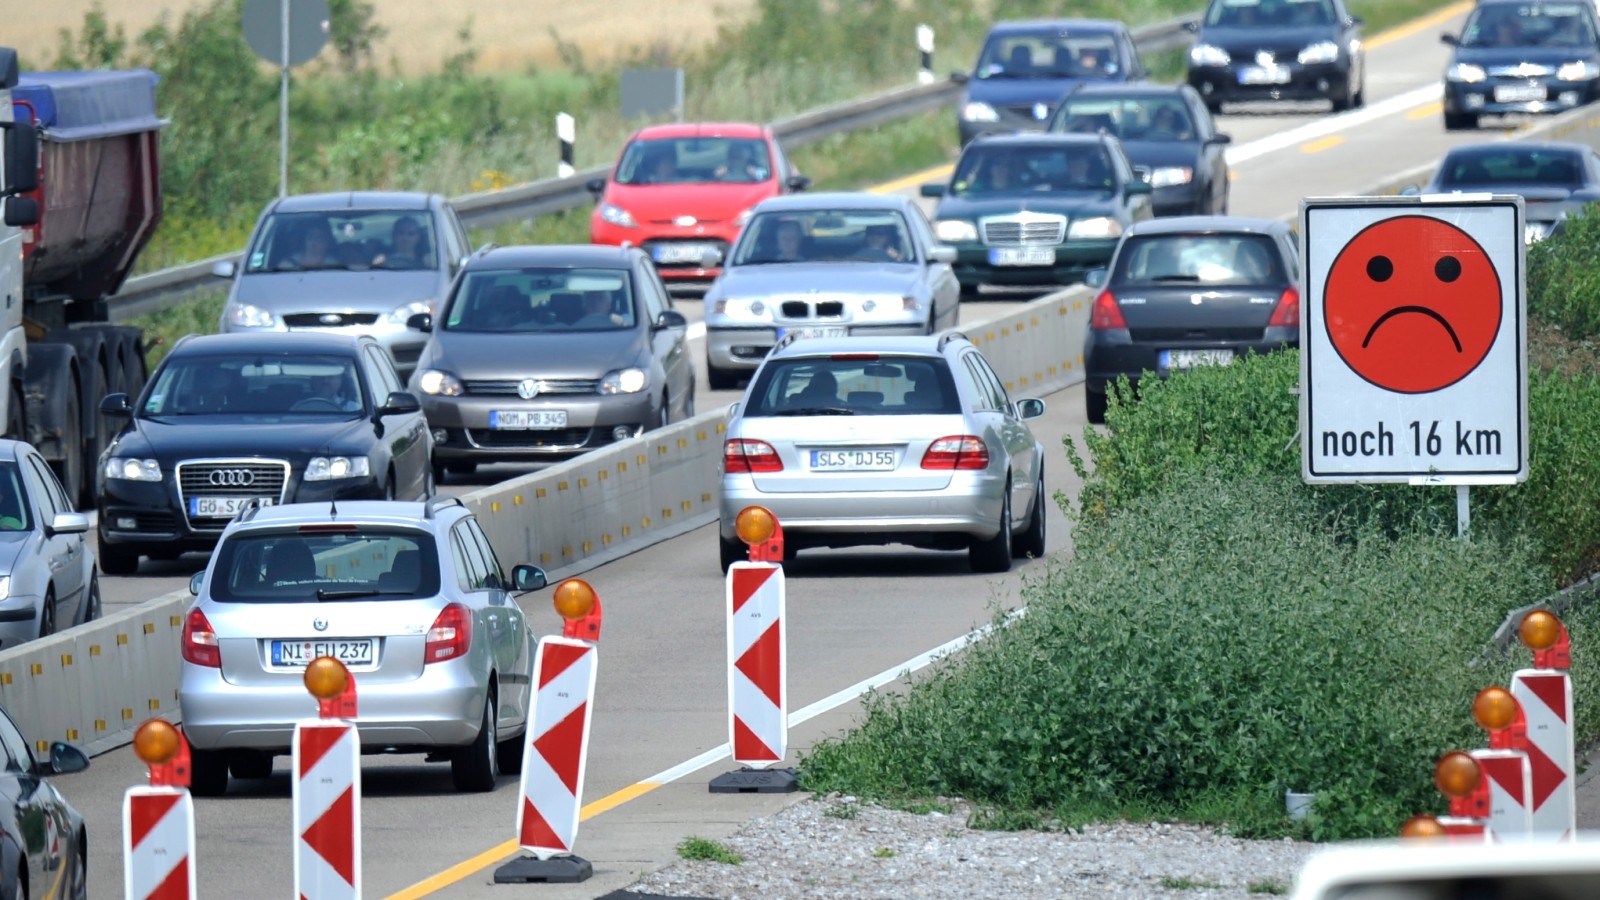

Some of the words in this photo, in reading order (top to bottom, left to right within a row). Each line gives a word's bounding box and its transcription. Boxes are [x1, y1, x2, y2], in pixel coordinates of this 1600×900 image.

[498, 413, 519, 424] NOM
[527, 413, 541, 425] PB
[1322, 421, 1394, 457] noch
[1409, 420, 1442, 456] 16
[1455, 420, 1502, 456] km
[819, 452, 846, 466] SLS
[855, 451, 873, 466] DJ
[875, 451, 893, 465] 55
[199, 499, 217, 513] GÖ
[282, 643, 302, 660] NI
[339, 643, 370, 659] 237
